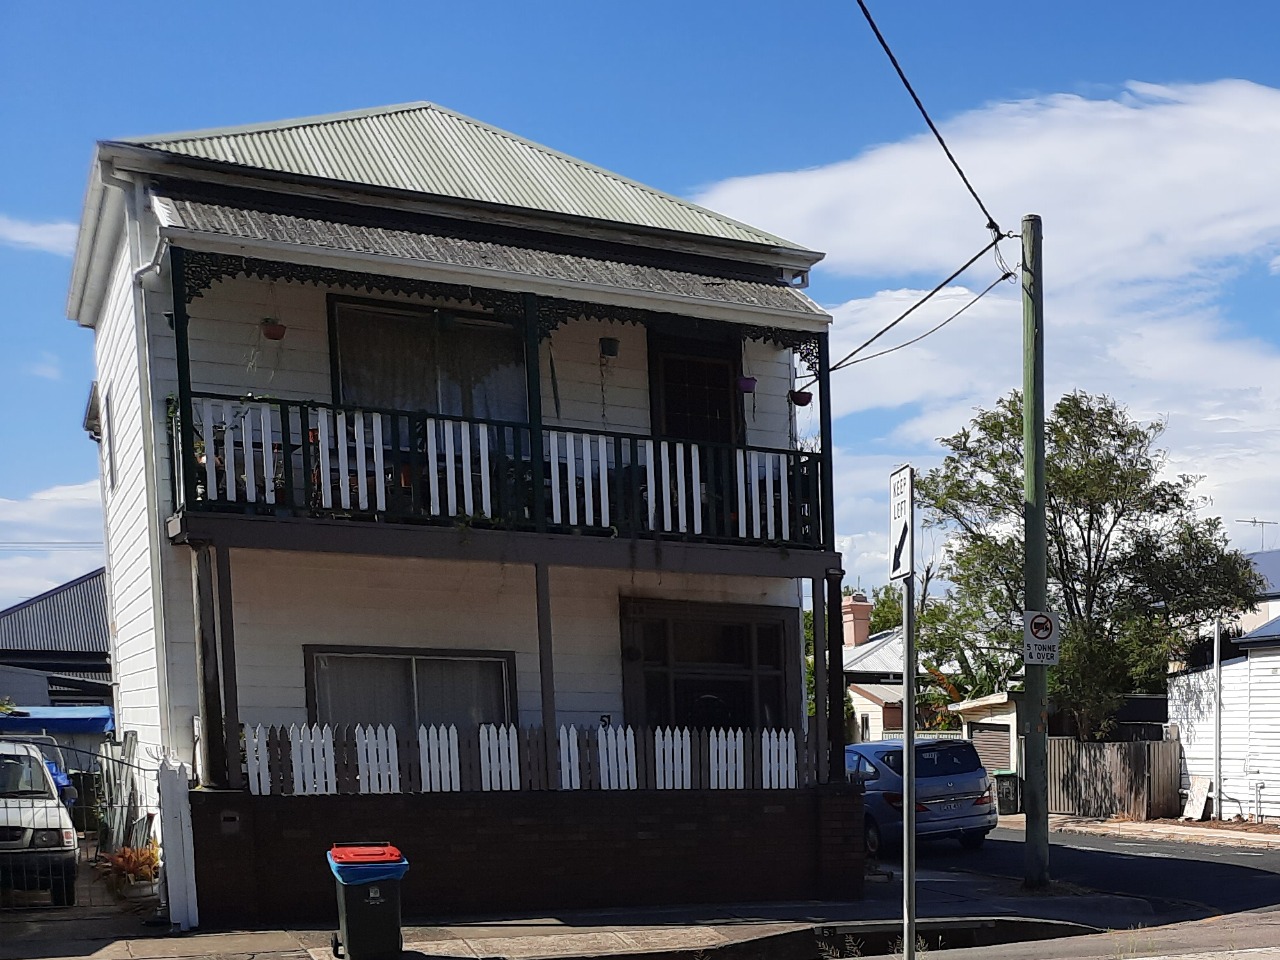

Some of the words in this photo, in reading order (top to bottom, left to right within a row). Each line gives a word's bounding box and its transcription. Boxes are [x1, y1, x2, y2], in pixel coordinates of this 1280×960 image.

[893, 477, 906, 498] KEEP
[894, 500, 906, 520] LEFT
[1026, 643, 1031, 651] 5
[1034, 643, 1056, 653] TONNE
[1028, 652, 1033, 660] &
[1036, 652, 1055, 661] OVER
